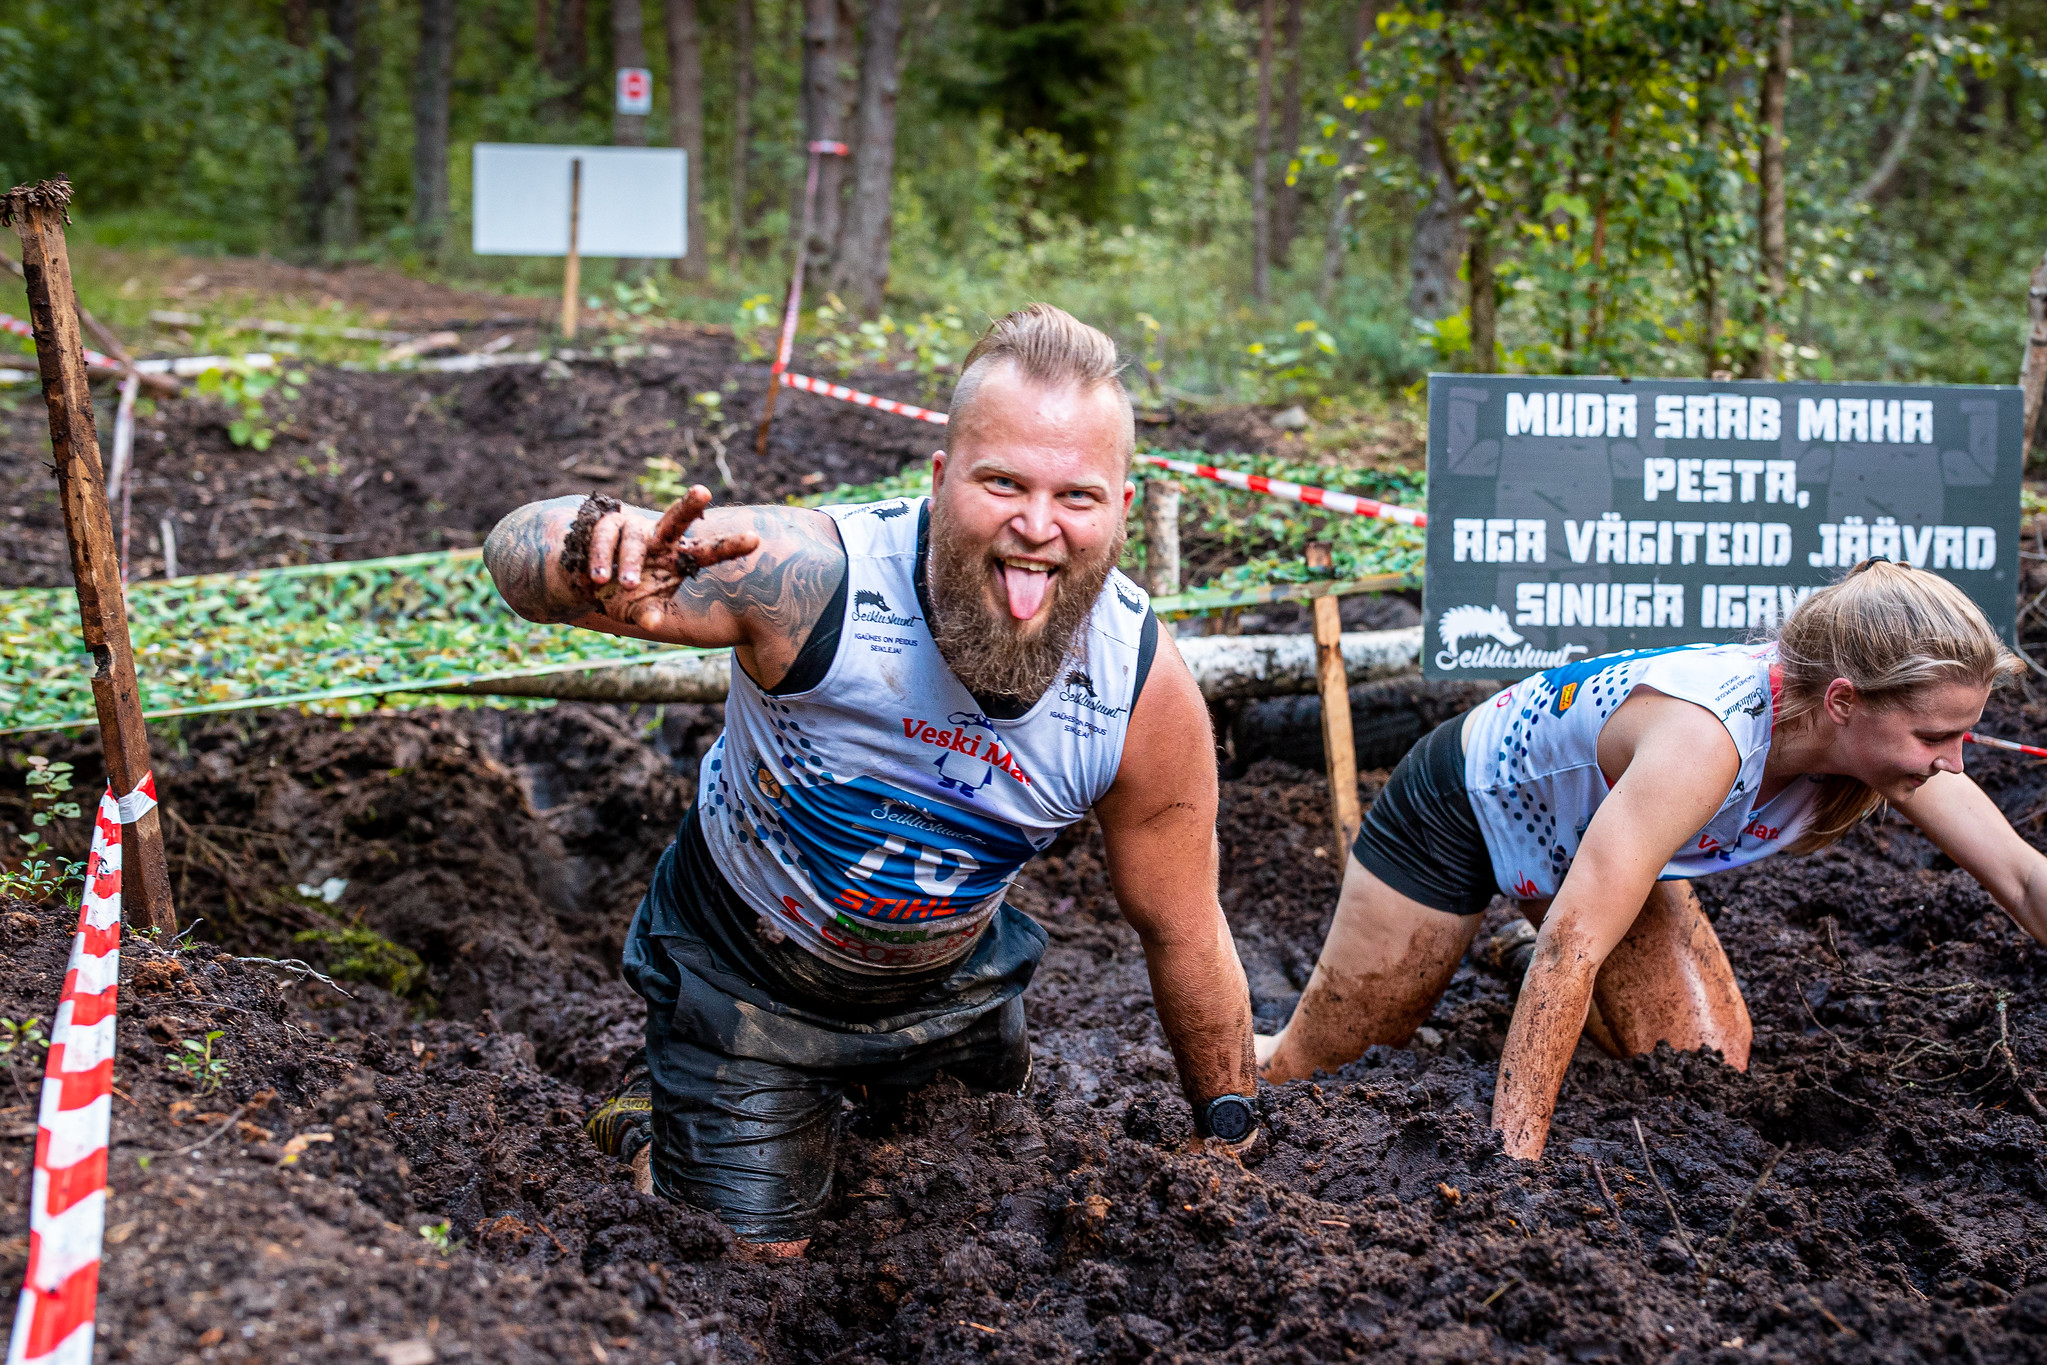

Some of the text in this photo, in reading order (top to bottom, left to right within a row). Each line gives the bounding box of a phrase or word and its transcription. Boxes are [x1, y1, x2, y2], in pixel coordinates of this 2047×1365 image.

[1505, 392, 1934, 444] MUDA SAAB MAHA
[1643, 457, 1811, 509] PESTA,
[1452, 511, 1998, 571] AGA VÄGITEOD JÄÄVAD
[1515, 582, 1832, 629] SINUGA IGAV
[1435, 640, 1589, 671] Seiklushunt
[902, 717, 983, 758] Veski
[833, 888, 957, 920] STIHL
